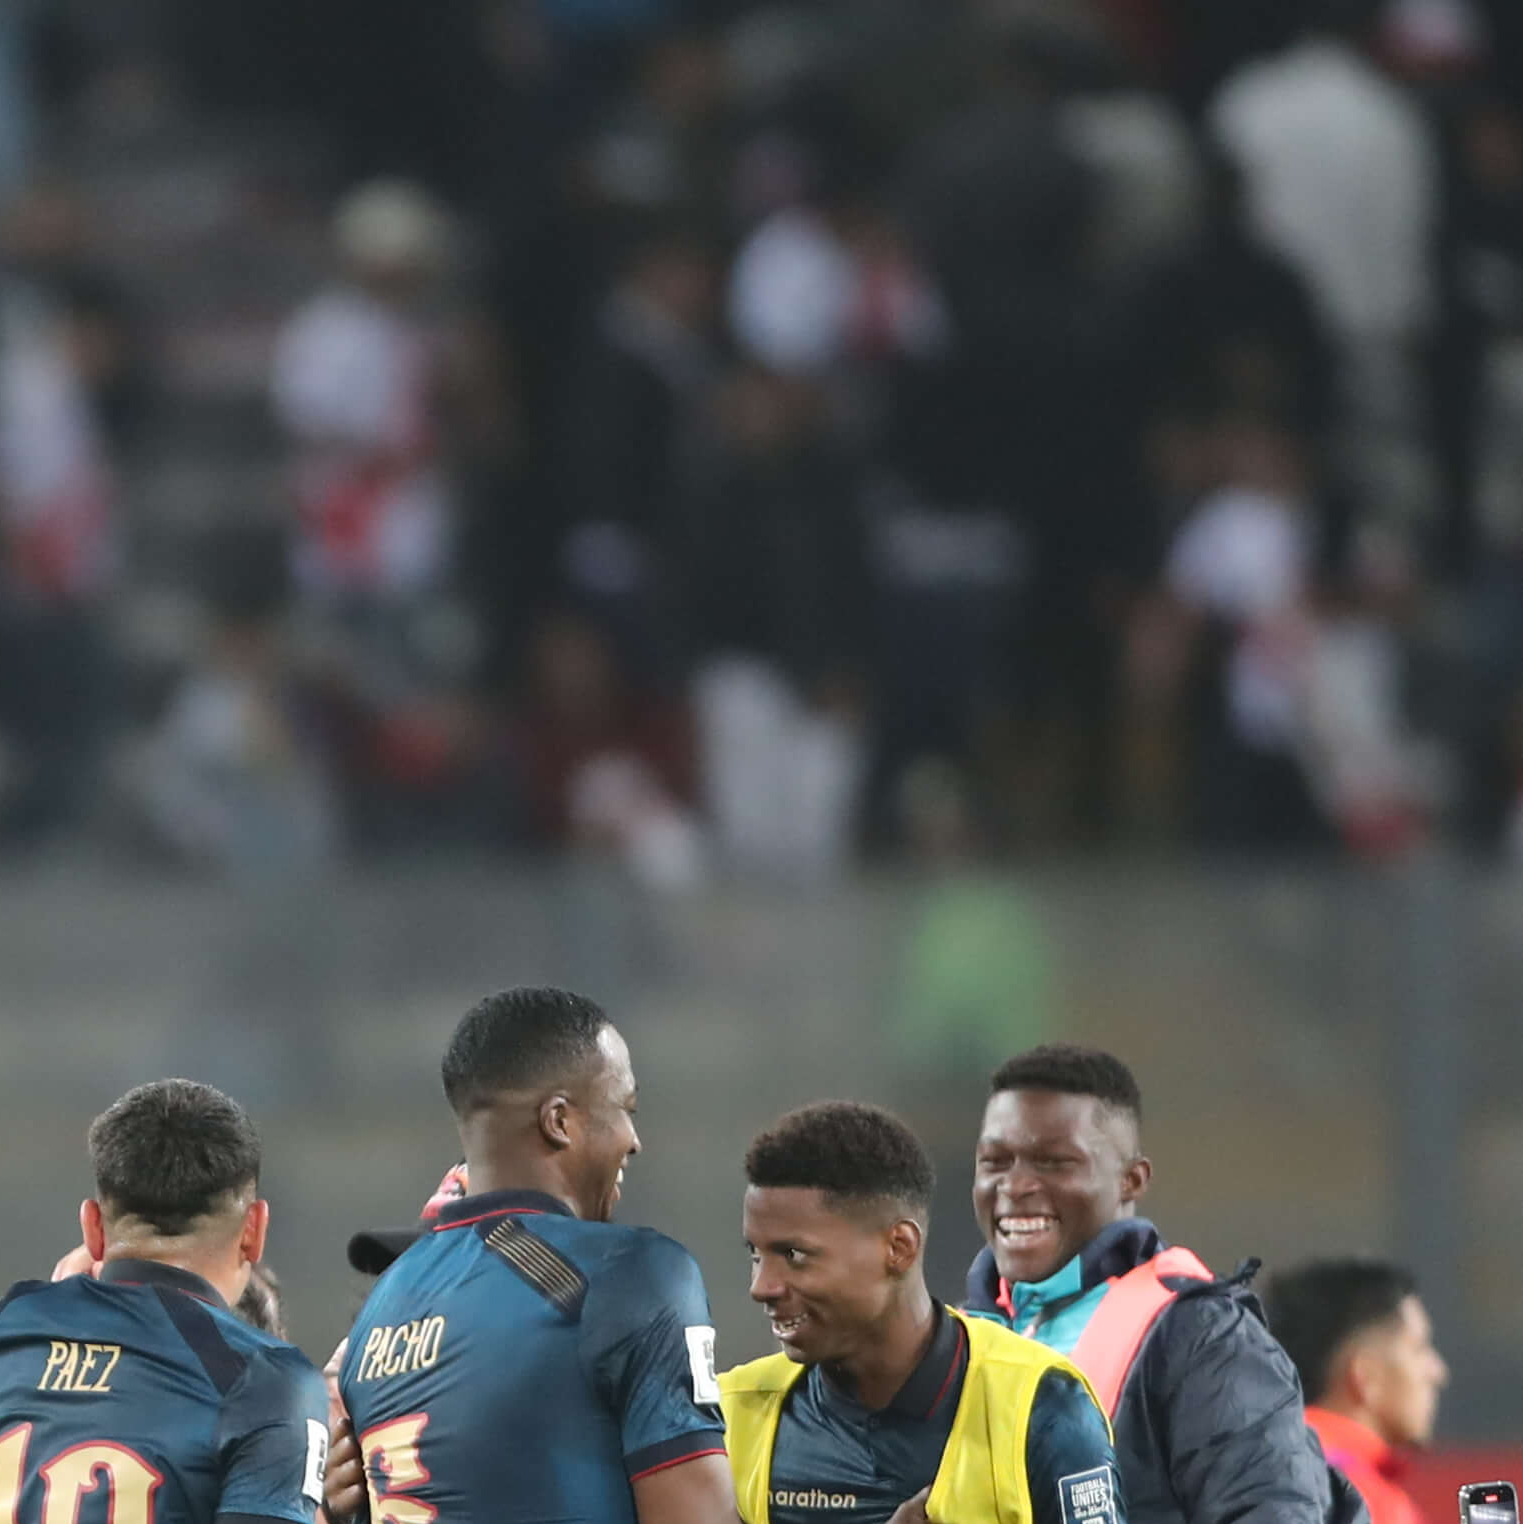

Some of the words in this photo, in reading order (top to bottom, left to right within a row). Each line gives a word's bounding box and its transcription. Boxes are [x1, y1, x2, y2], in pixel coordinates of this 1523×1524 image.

[357, 1315, 445, 1384] PACHO
[36, 1340, 122, 1393] PAEZ
[1071, 1477, 1108, 1494] FOOTBALL
[768, 1488, 857, 1509] arathon
[1072, 1487, 1109, 1507] UNITES
